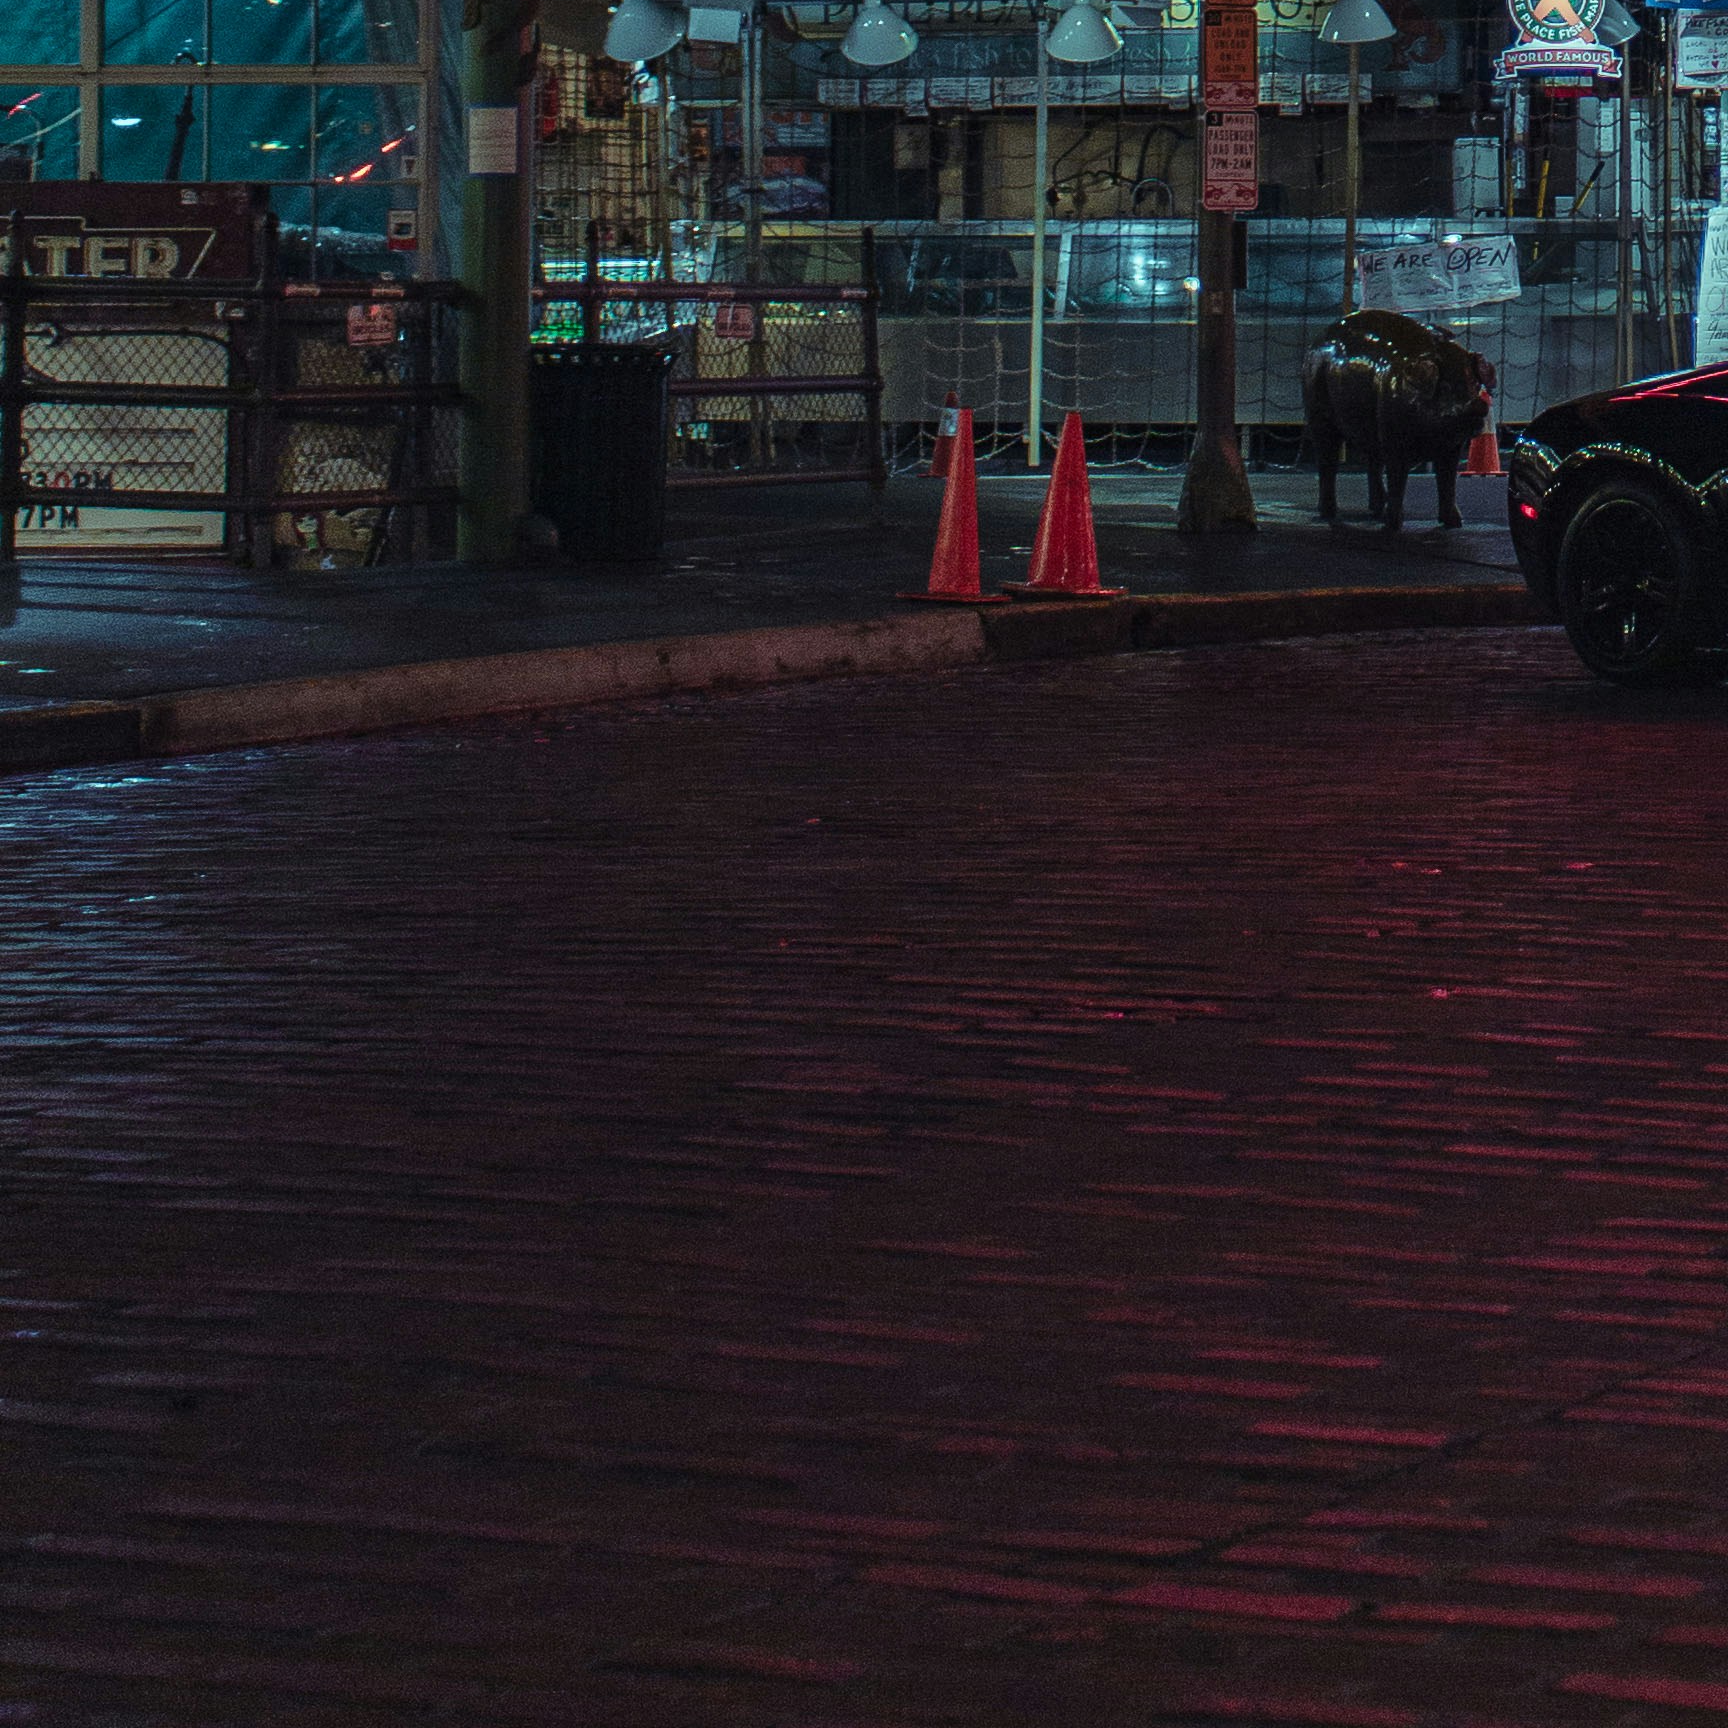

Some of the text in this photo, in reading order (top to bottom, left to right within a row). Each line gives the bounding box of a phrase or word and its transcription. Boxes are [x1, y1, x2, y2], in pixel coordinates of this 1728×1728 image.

[1520, 12, 1556, 40] PLACE
[1506, 51, 1610, 63] WORLD FAMOUS
[1208, 129, 1255, 142] PASSENGER
[1208, 143, 1255, 155] LOAD ONLY
[1362, 242, 1514, 274] WE ARE OPEN
